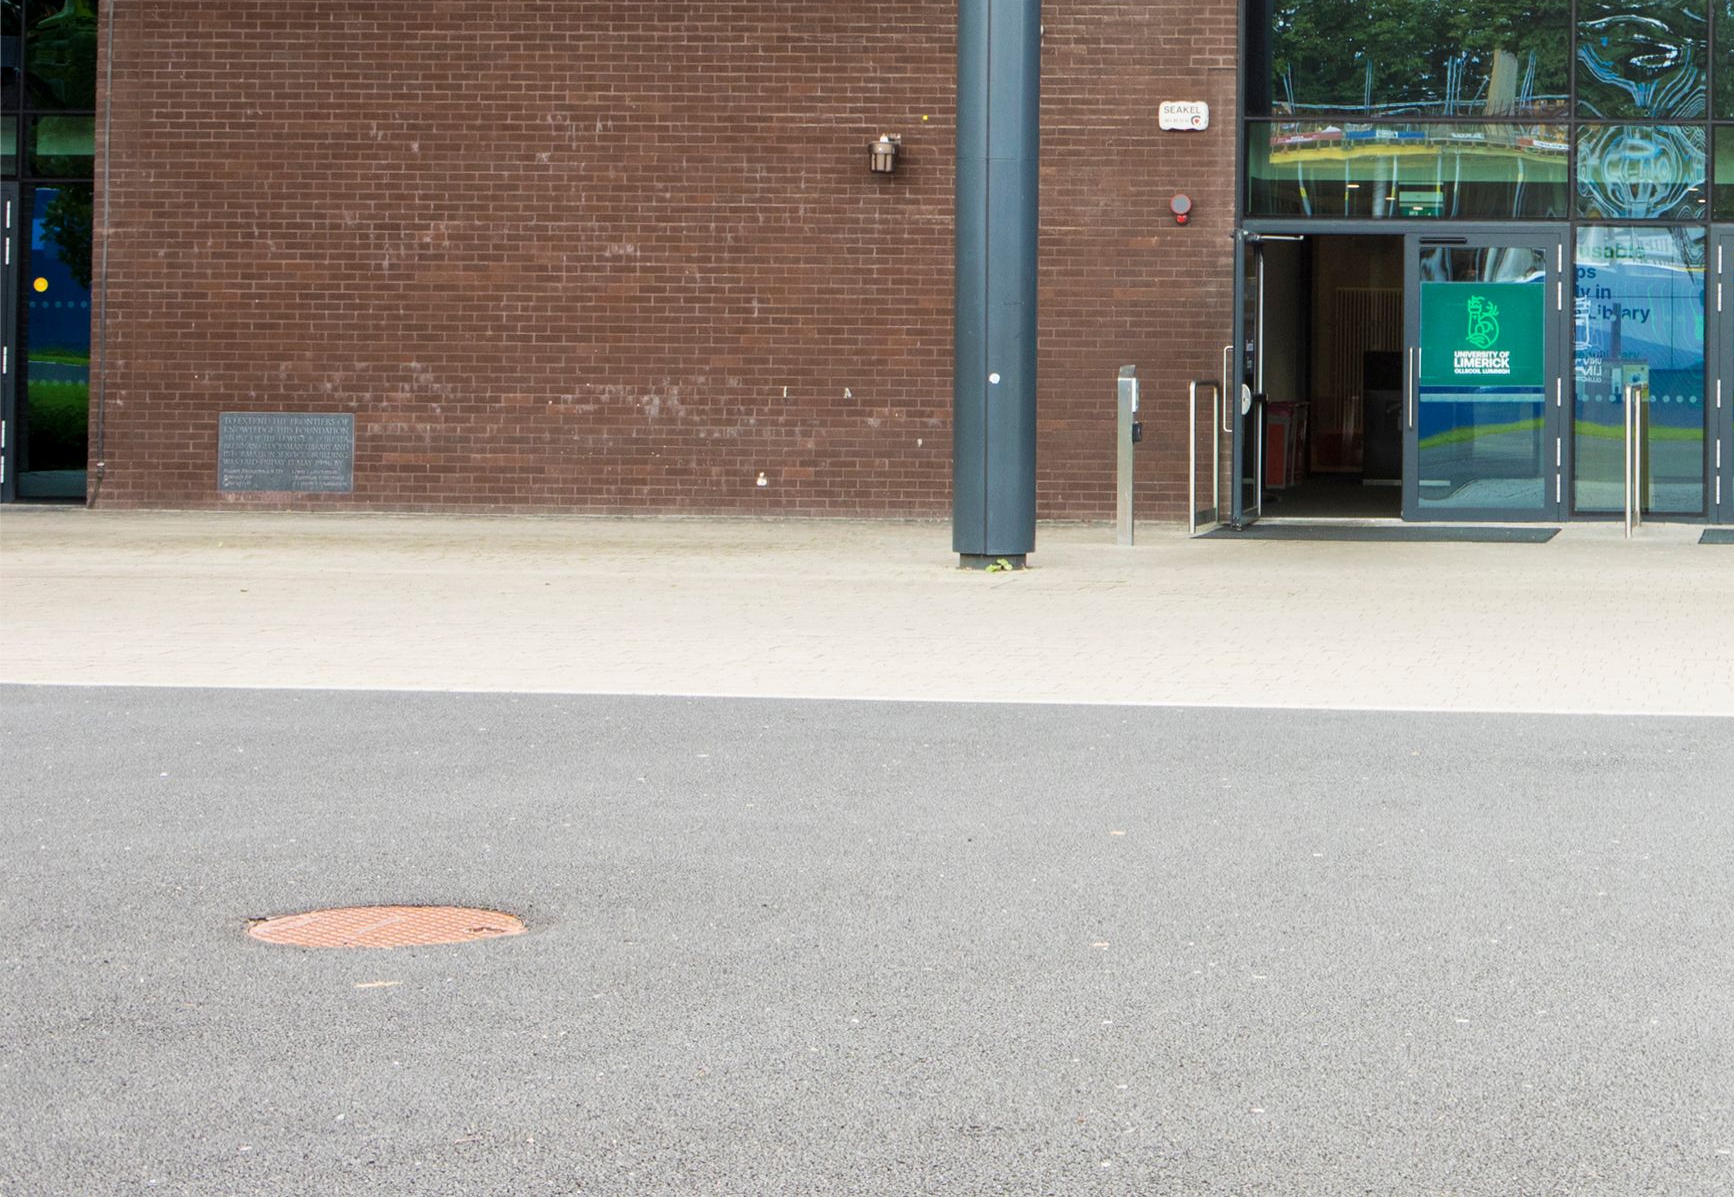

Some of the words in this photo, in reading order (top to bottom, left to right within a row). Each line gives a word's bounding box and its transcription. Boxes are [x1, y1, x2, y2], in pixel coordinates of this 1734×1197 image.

[1164, 105, 1201, 114] SEAKEL
[1578, 243, 1646, 260] usable
[1575, 267, 1597, 282] ps
[1595, 284, 1612, 299] in
[1588, 304, 1651, 324] ibary
[1454, 358, 1510, 368] LIMERICK
[224, 417, 236, 425] TO
[236, 417, 270, 425] EXTEND
[272, 417, 286, 425] THE
[289, 417, 335, 426] FRONTIERS
[337, 417, 349, 426] OF
[223, 426, 273, 434] KNOWLEDGE
[276, 426, 293, 434] THIS
[295, 426, 349, 435] FOUNDATION
[223, 458, 240, 466] WAS
[296, 458, 315, 467] MAY
[334, 459, 344, 467] BY
